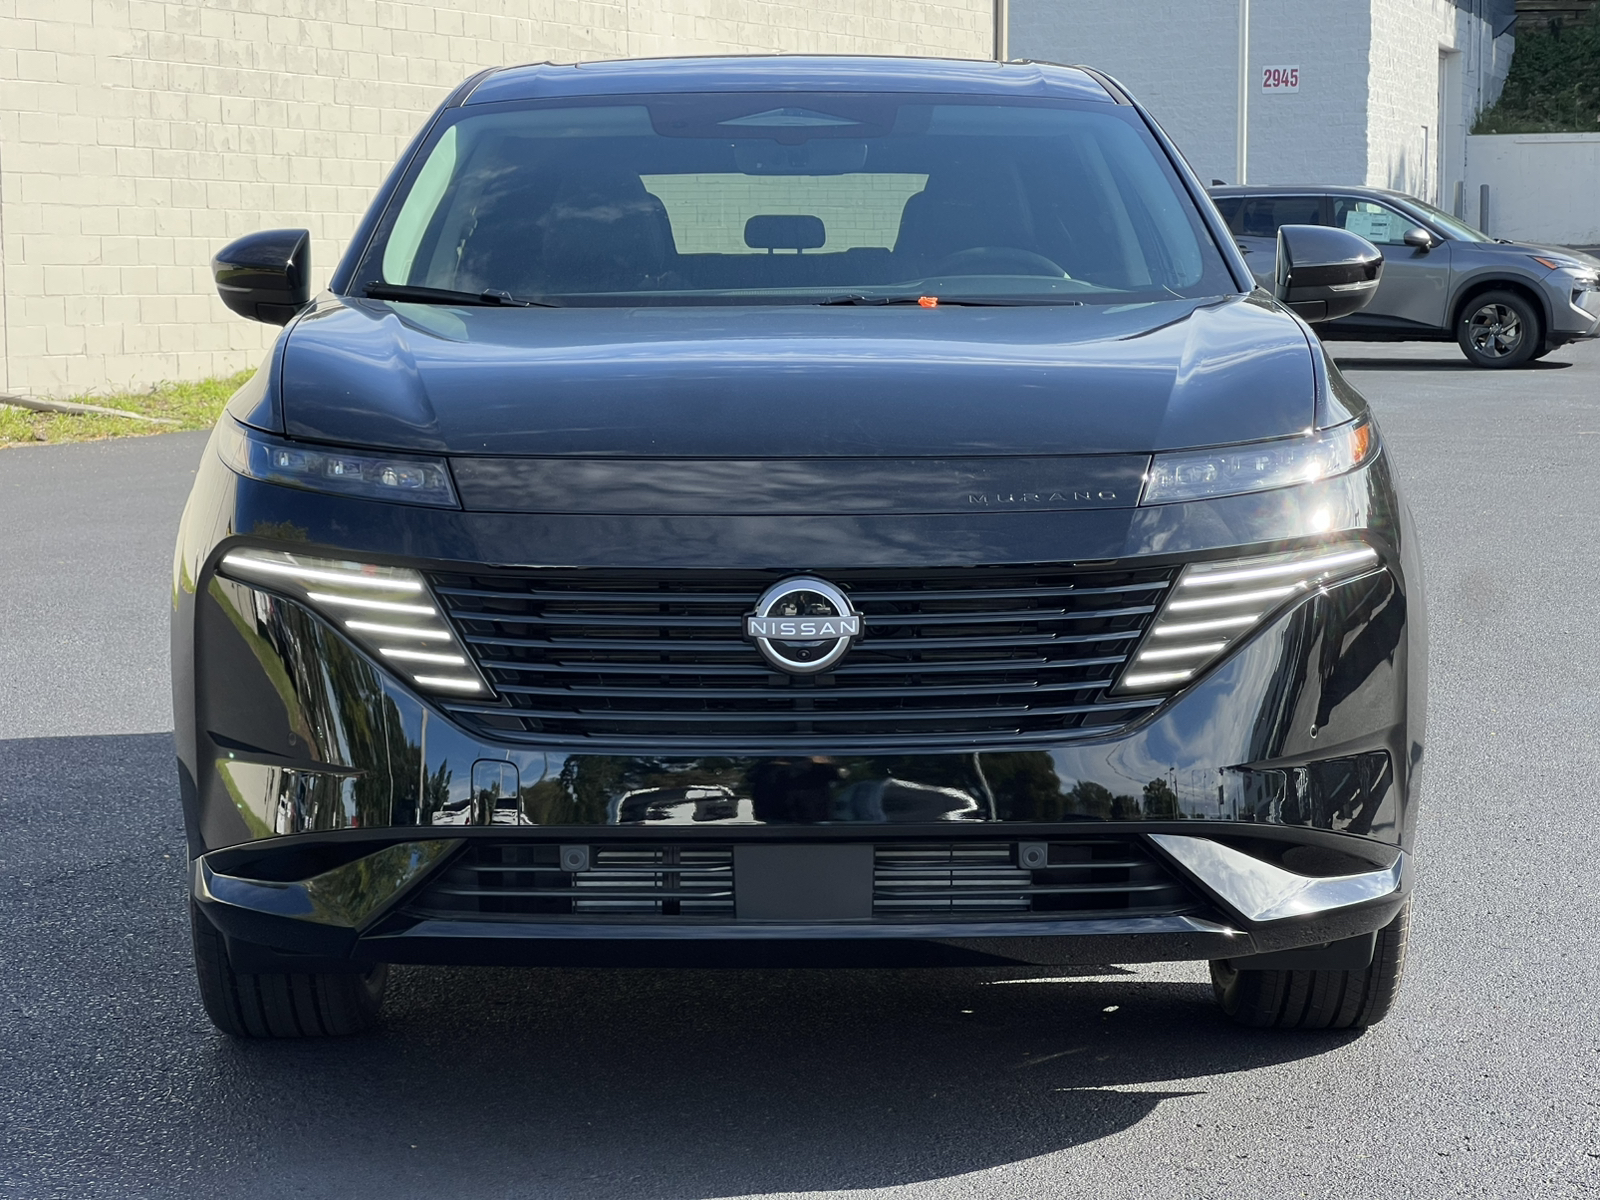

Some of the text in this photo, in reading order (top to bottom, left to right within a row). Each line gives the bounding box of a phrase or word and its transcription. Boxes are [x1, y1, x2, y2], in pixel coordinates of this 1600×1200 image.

[1263, 68, 1298, 88] 2945
[967, 491, 1117, 504] MURANO
[750, 619, 857, 636] NISSAN
